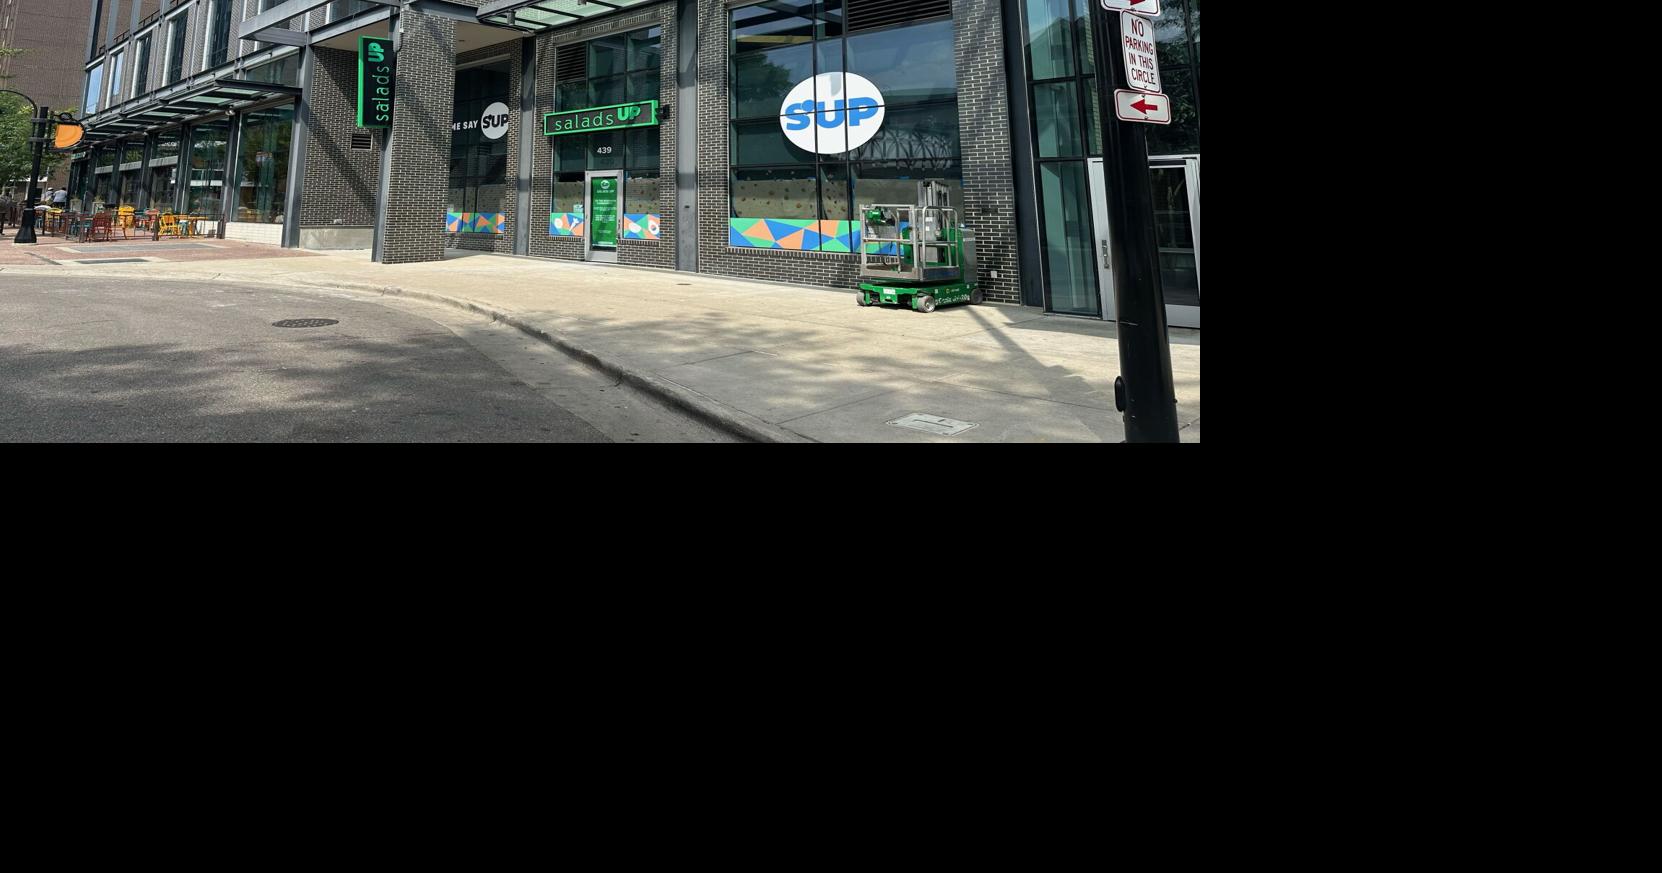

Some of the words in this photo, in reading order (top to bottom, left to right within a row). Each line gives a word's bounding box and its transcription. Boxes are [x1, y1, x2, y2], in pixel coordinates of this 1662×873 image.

[1131, 19, 1144, 37] NO
[367, 42, 385, 63] UP
[1125, 36, 1154, 55] PARKING
[1128, 53, 1137, 66] IN
[1138, 55, 1154, 70] THIS
[1131, 67, 1156, 85] CIRCLE
[371, 66, 390, 121] salads
[462, 119, 479, 130] SAY
[554, 111, 614, 131] salads
[617, 105, 641, 121] UP
[596, 146, 612, 154] 439
